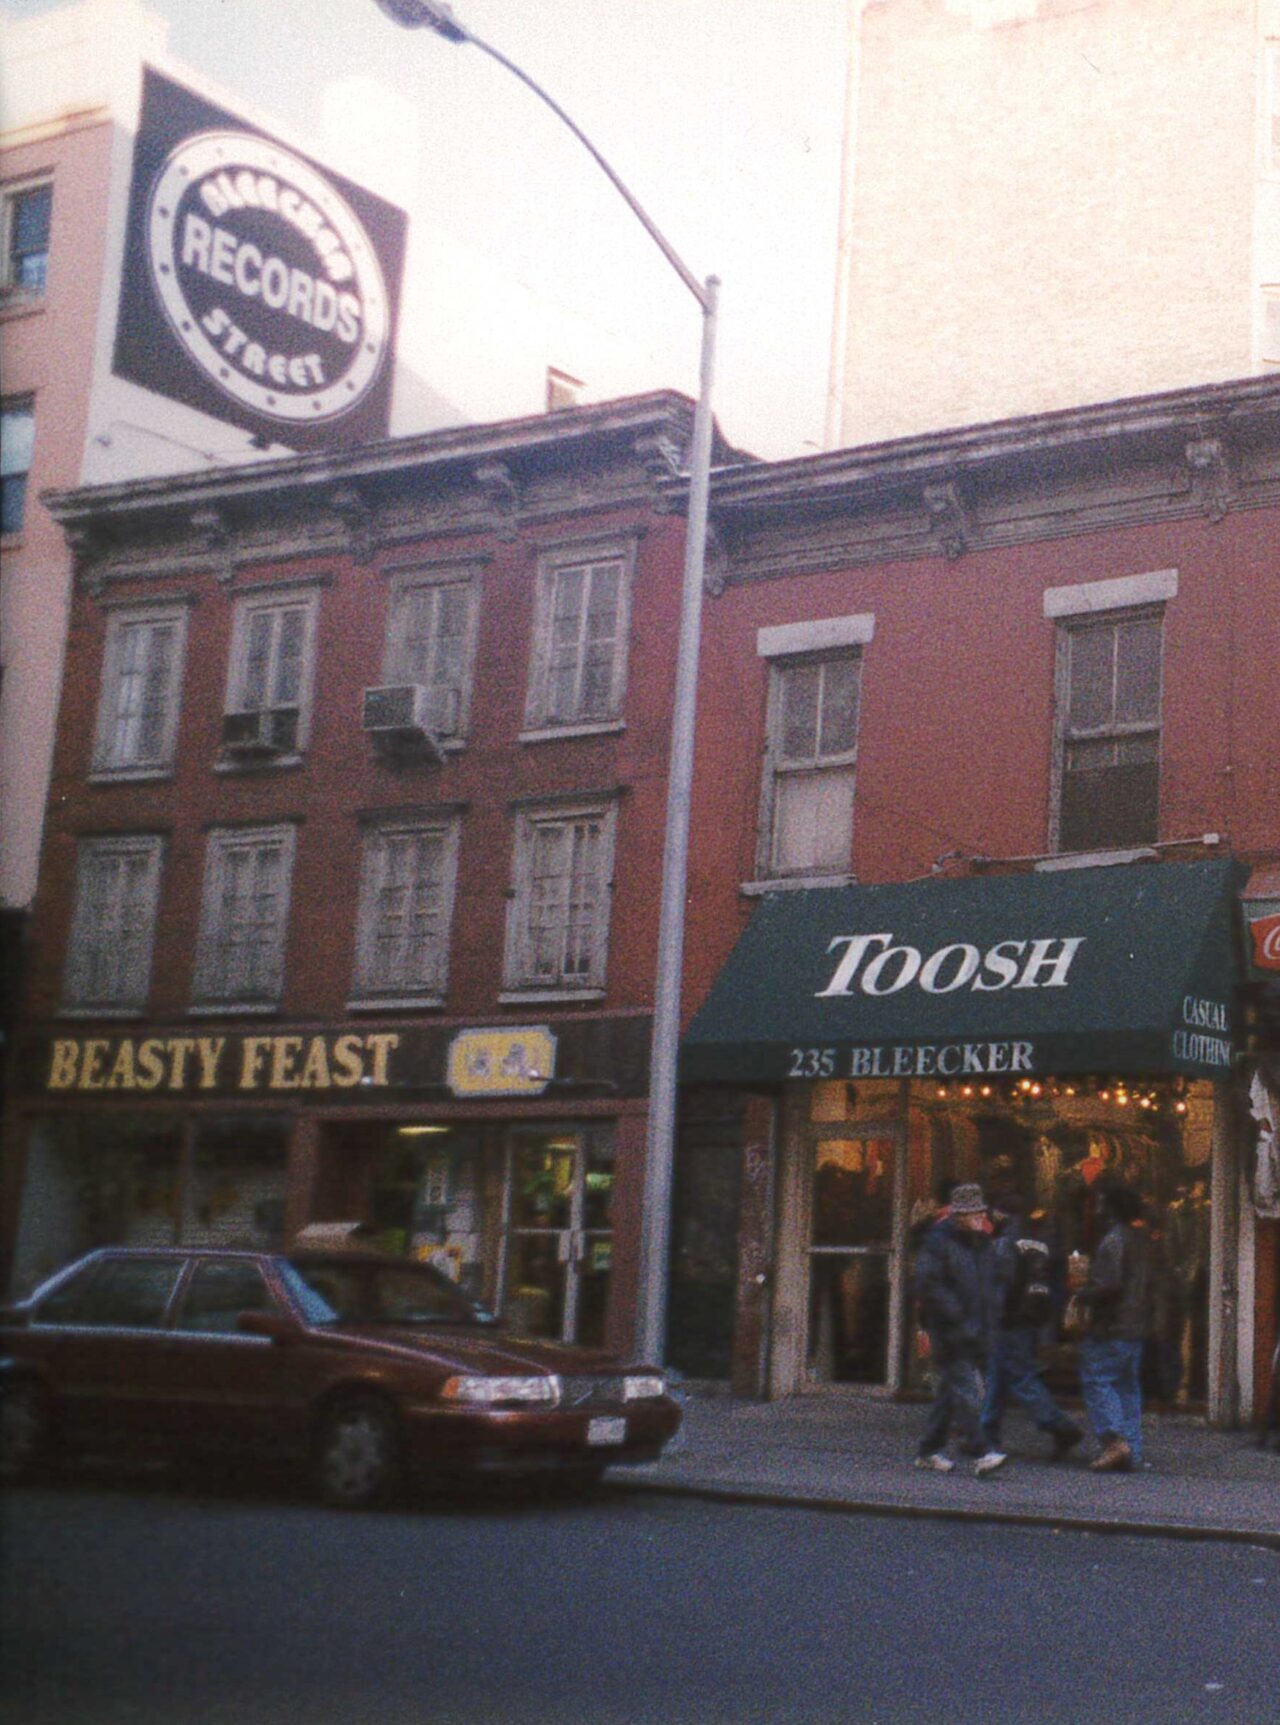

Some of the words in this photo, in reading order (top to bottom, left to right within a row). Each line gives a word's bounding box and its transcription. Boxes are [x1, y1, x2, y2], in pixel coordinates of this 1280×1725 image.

[183, 213, 361, 343] RECORDS
[202, 308, 325, 386] STREET
[814, 933, 1088, 998] TOOSH
[1182, 995, 1228, 1032] CASUAL
[46, 1038, 225, 1090] BEASTY
[238, 1033, 400, 1089] FEAST
[789, 1047, 836, 1078] 235
[849, 1041, 1034, 1078] BLEECKER
